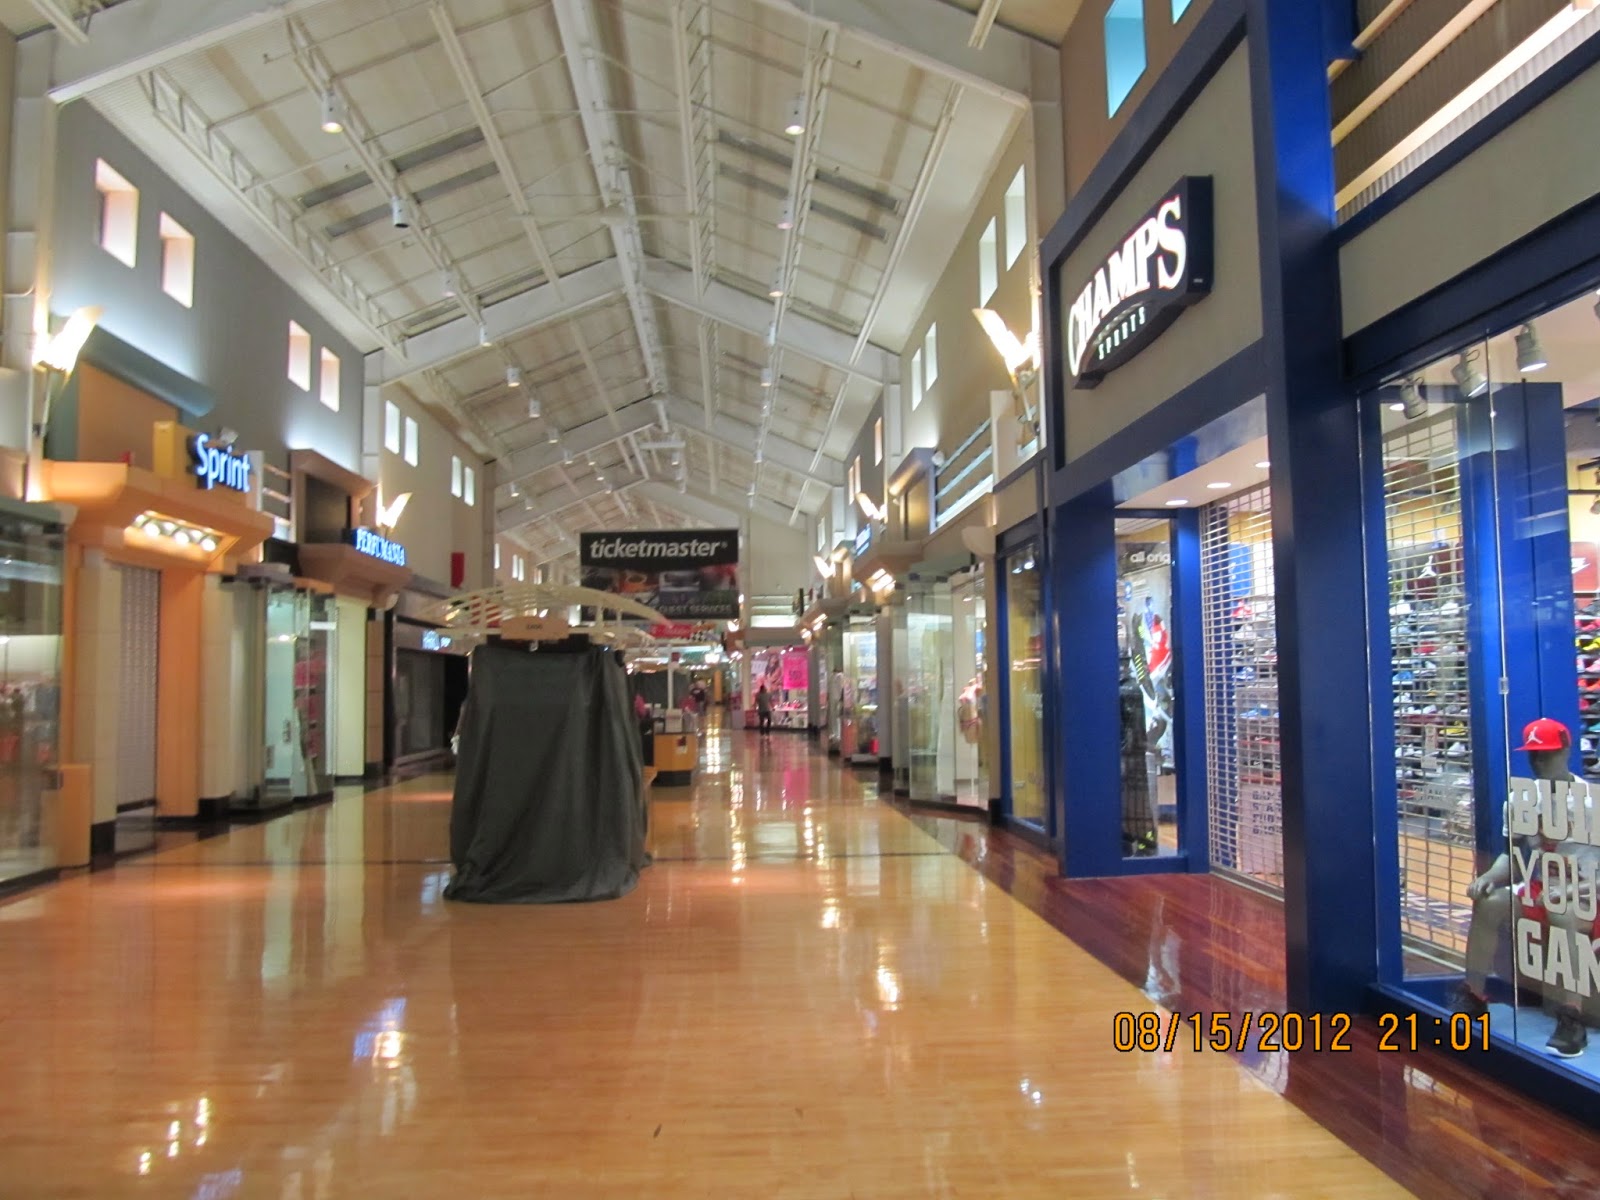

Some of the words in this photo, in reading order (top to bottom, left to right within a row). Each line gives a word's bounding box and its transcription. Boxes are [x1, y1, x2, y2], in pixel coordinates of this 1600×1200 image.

[1068, 194, 1187, 377] CHAMPS
[1098, 306, 1146, 360] SPORTS
[196, 433, 251, 493] Sprint
[589, 537, 721, 559] ticketmaster
